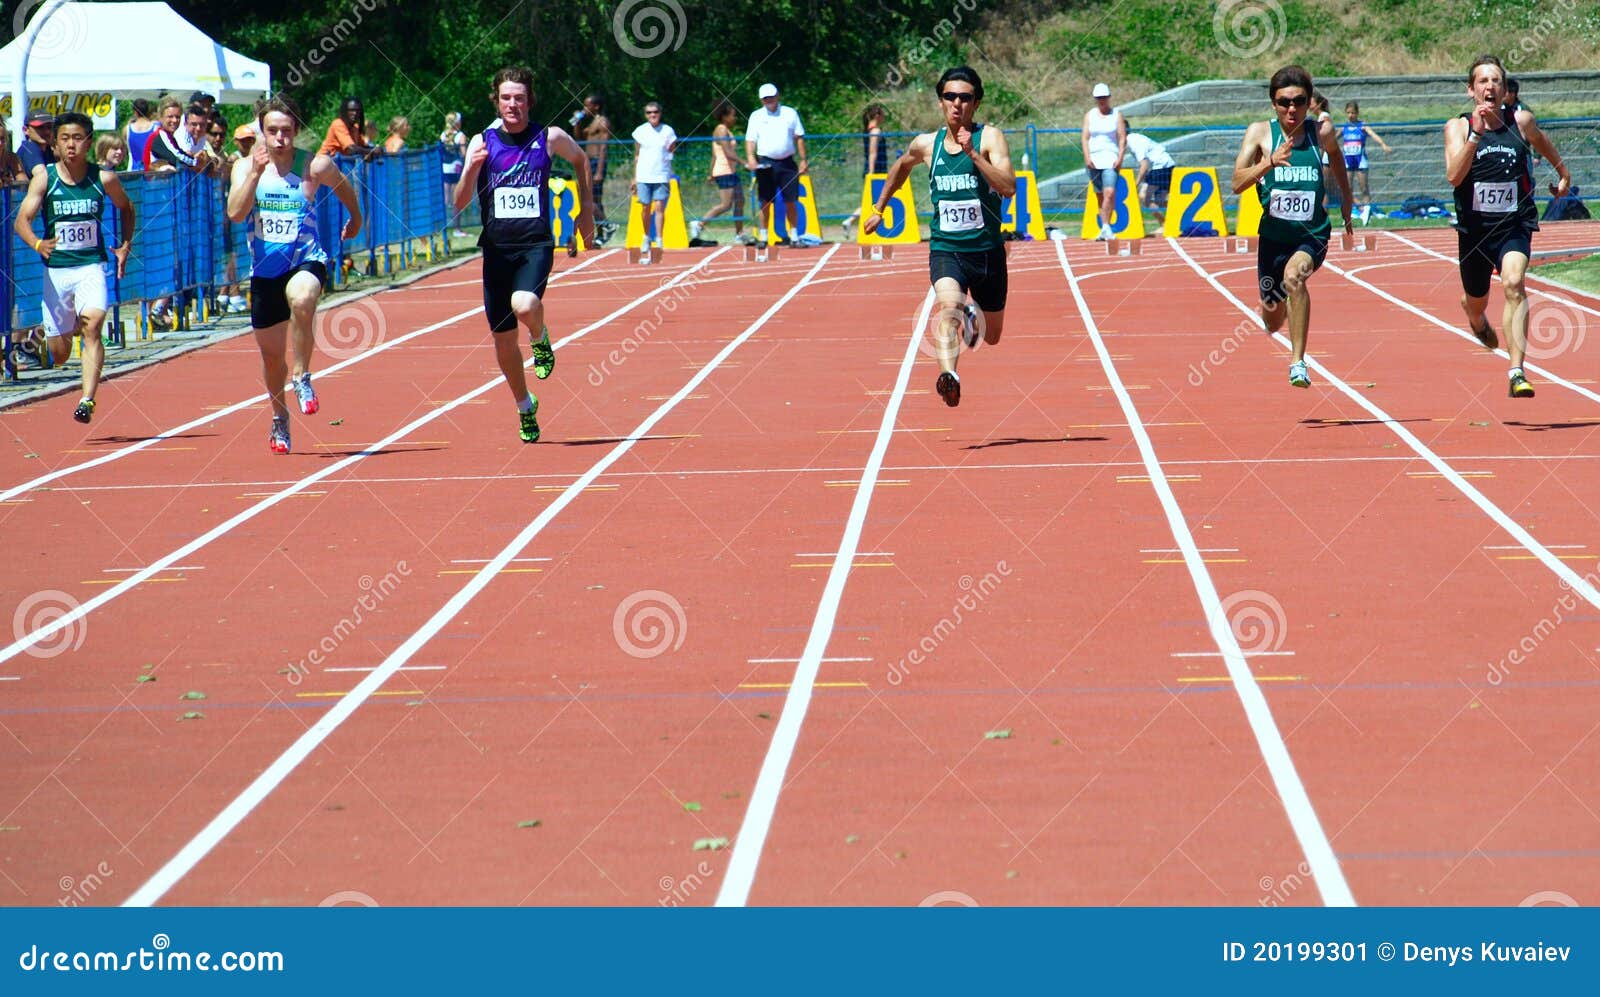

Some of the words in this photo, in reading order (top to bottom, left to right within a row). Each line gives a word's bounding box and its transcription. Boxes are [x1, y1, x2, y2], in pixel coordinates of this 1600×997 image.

[934, 173, 979, 192] Royals
[1274, 166, 1319, 183] Royals
[500, 194, 535, 209] 1394
[1180, 171, 1213, 232] 2
[1479, 188, 1514, 204] 1574
[53, 199, 99, 215] Royals
[871, 180, 905, 238] 5
[1275, 196, 1310, 213] 1380
[943, 207, 977, 223] 1378
[259, 218, 293, 234] 1367
[60, 227, 92, 242] 1381
